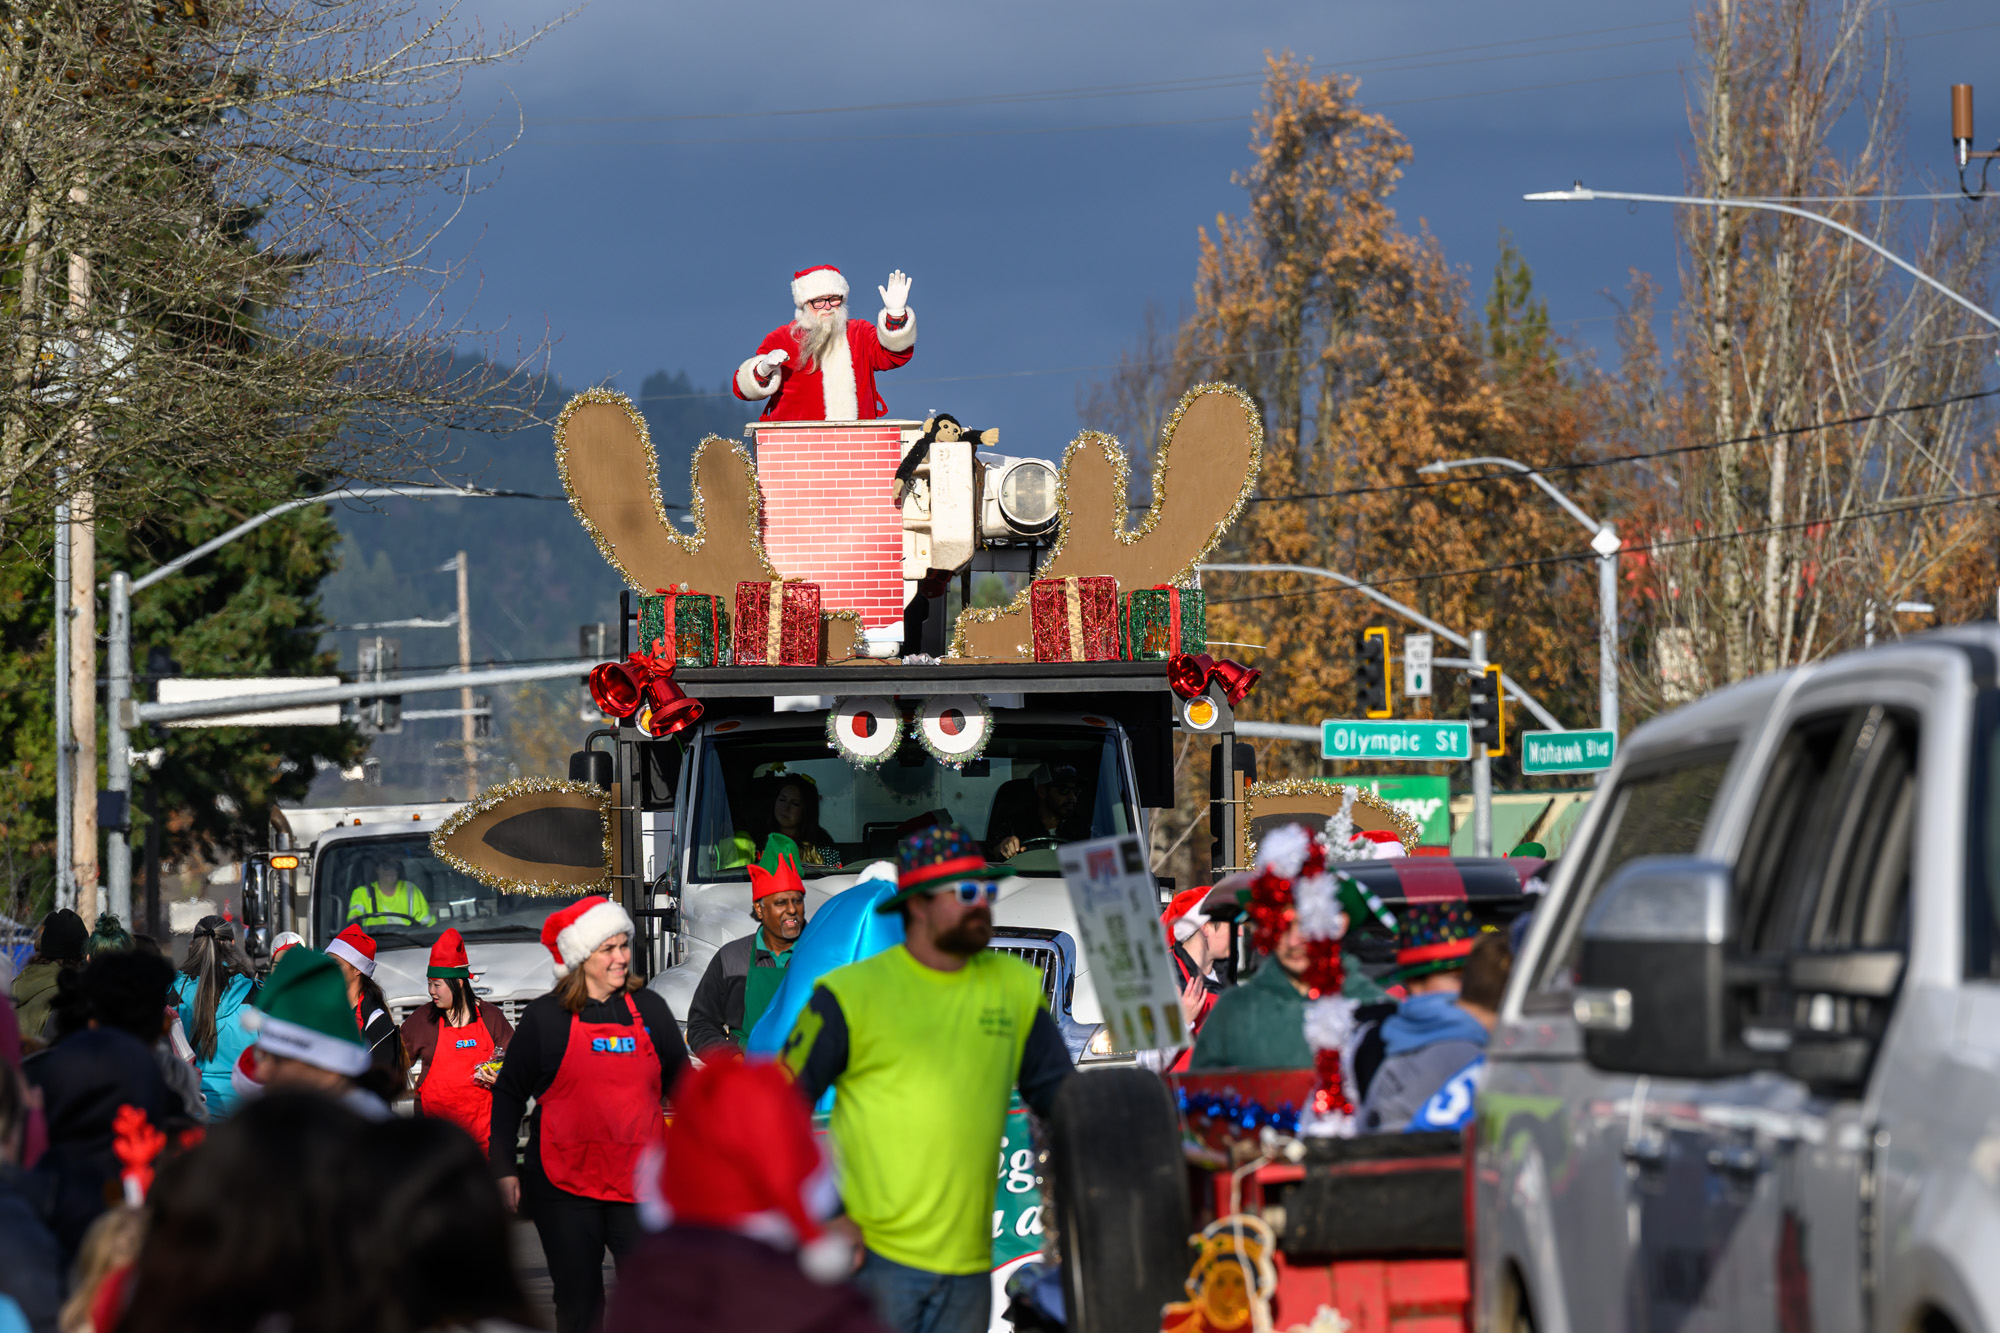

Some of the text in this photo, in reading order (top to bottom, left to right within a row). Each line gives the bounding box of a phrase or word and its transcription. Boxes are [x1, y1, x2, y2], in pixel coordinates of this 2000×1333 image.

[1333, 727, 1459, 755] Olympic St
[1528, 739, 1609, 765] Mohawk Blvd
[454, 1039, 477, 1048] SUB
[591, 1036, 636, 1053] SUB
